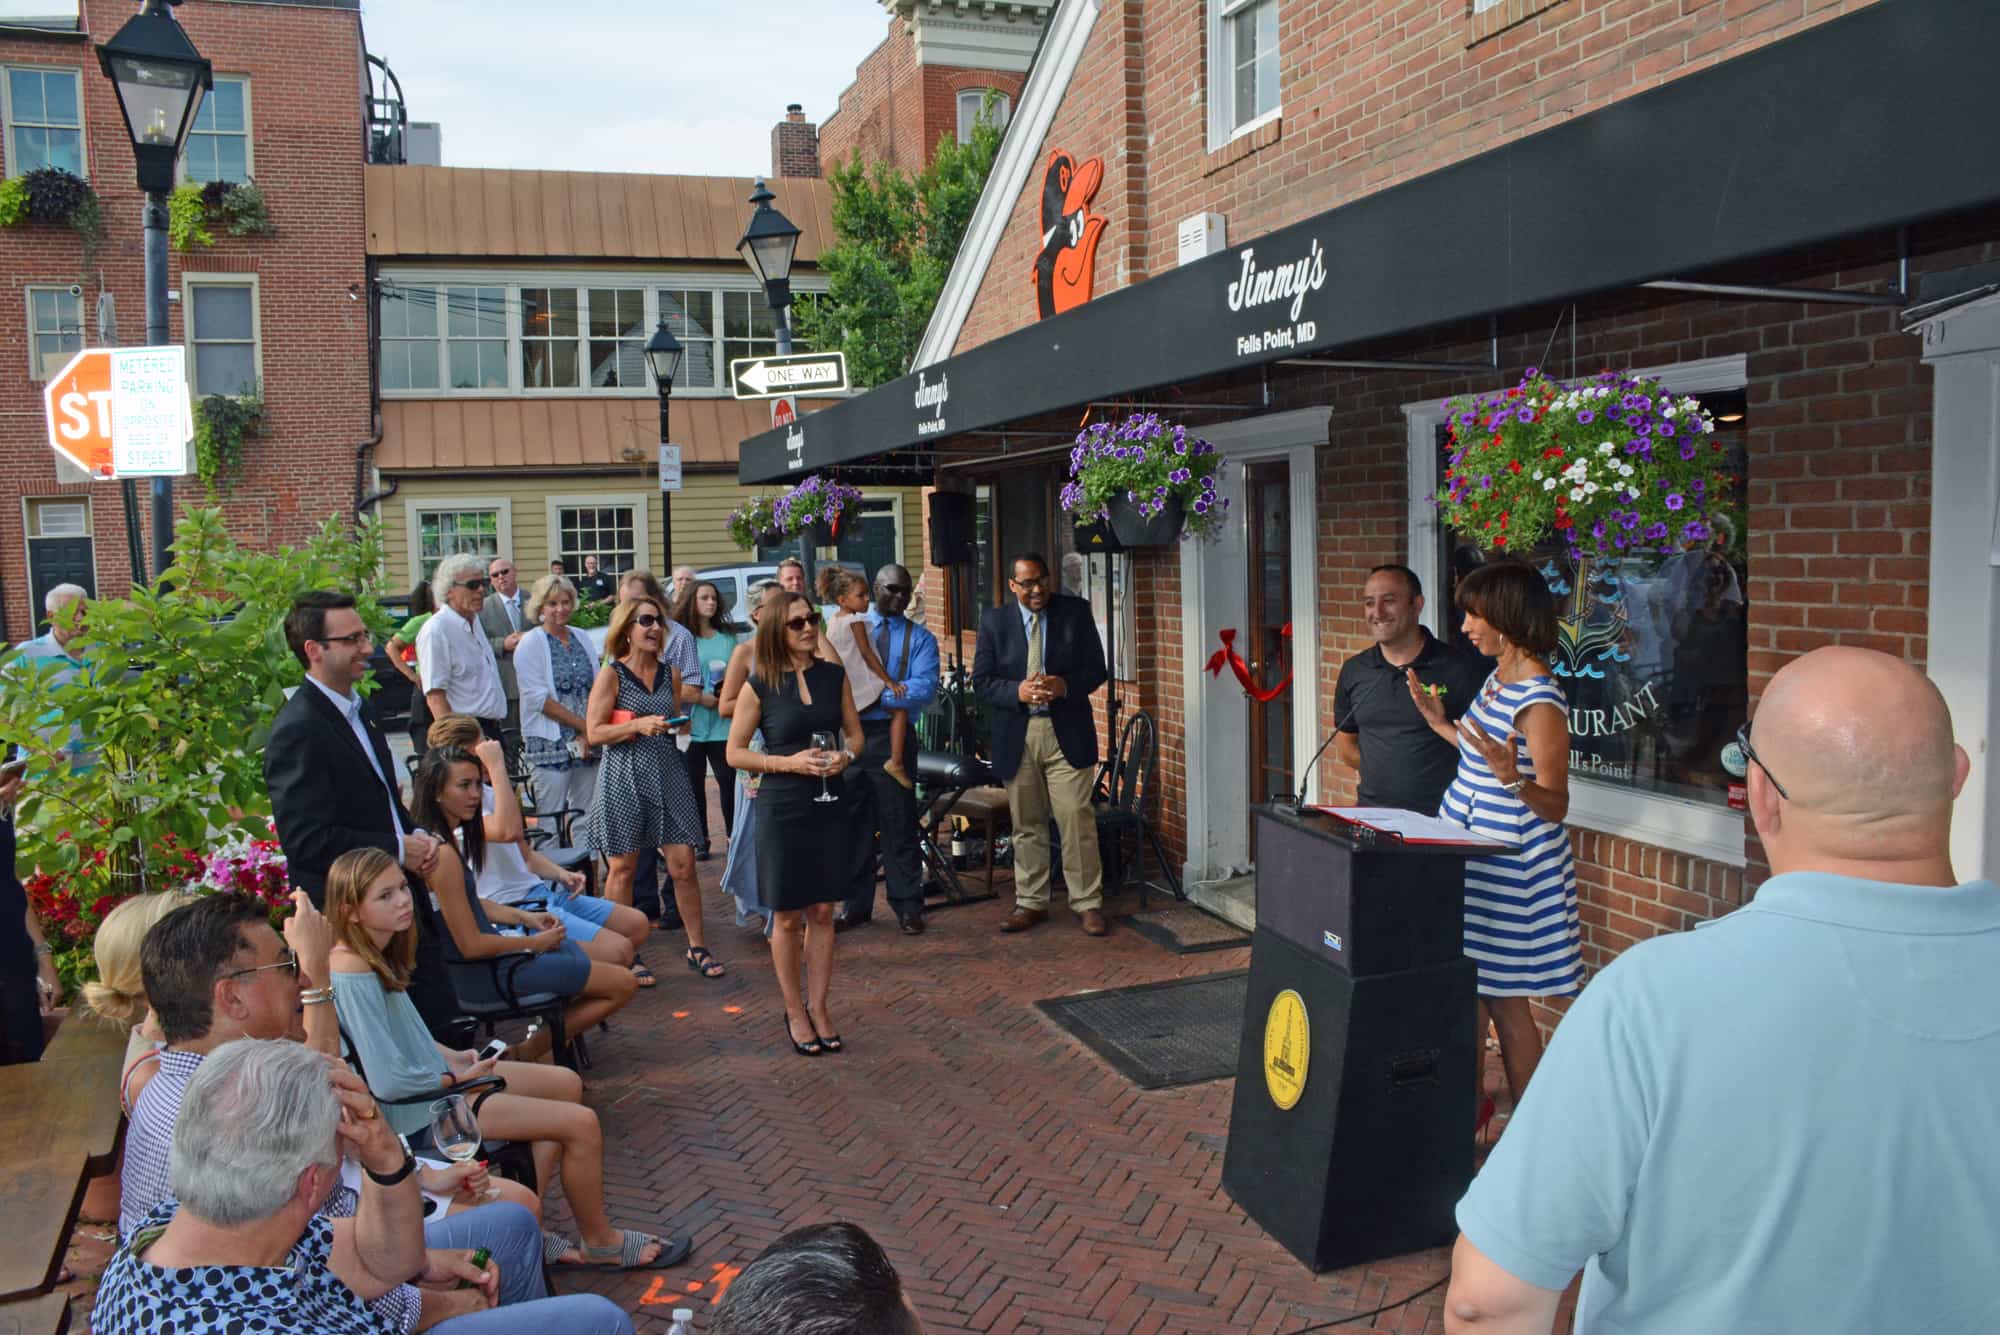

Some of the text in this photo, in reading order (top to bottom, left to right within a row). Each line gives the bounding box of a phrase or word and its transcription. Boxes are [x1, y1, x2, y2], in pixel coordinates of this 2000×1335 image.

[1228, 238, 1327, 321] Jimmy's
[1237, 321, 1316, 356] Fells Point, MD
[119, 357, 176, 374] METERED
[767, 366, 831, 384] ONE WAY
[120, 379, 175, 394] PARKING
[915, 372, 948, 418] Jimmy's
[1591, 753, 1630, 779] Point
